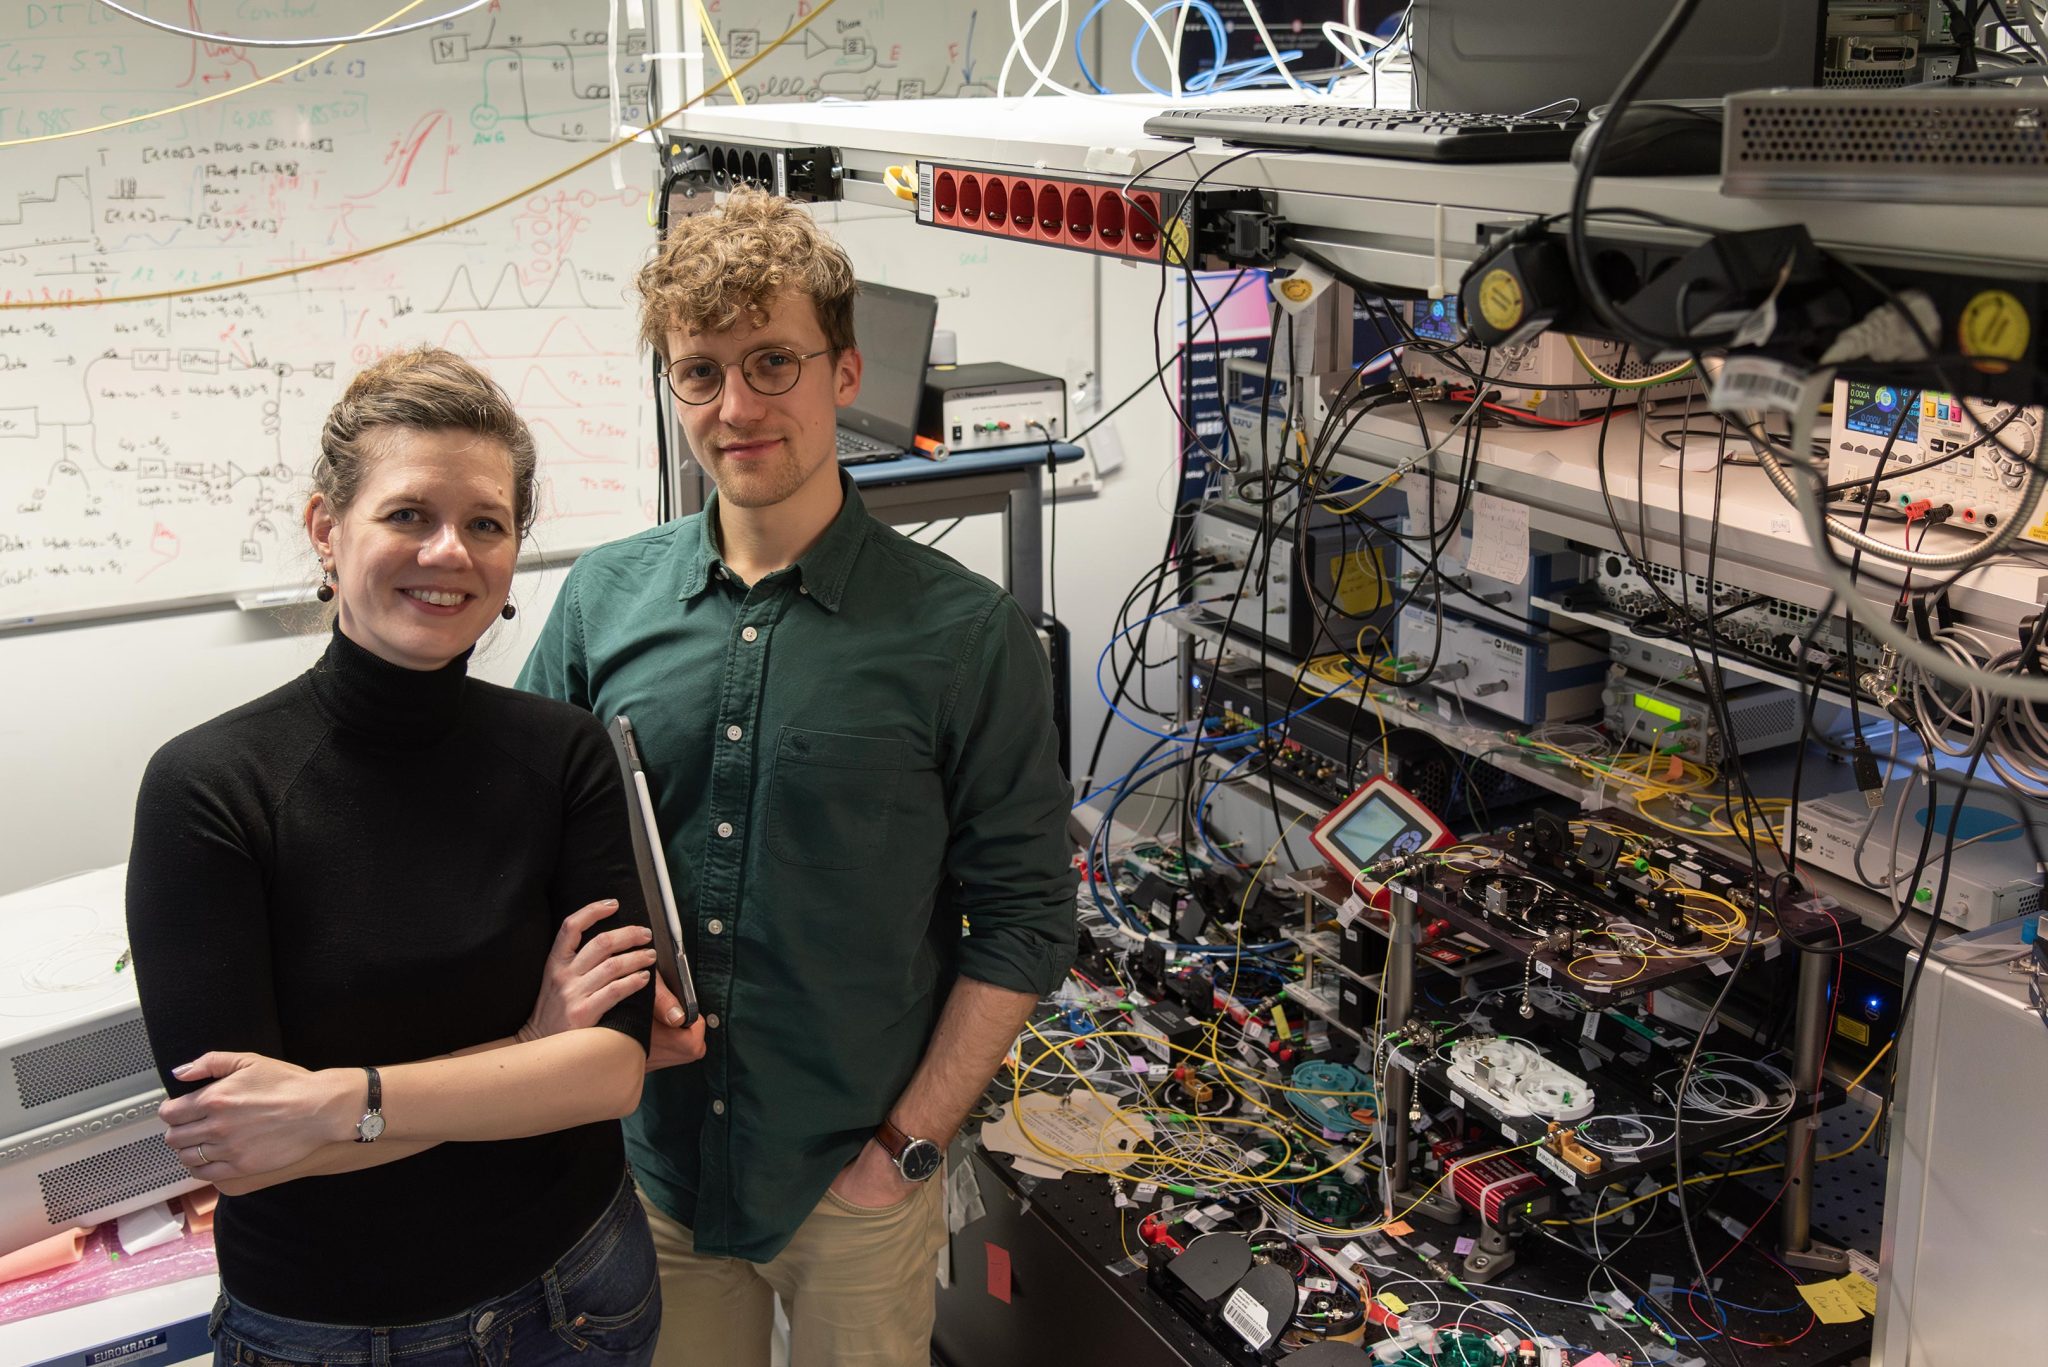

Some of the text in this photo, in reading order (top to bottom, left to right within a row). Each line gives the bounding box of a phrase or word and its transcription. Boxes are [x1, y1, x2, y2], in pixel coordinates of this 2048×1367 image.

[888, 44, 901, 61] E
[1502, 641, 1524, 657] Polytec
[1654, 927, 1676, 942] FPC030
[94, 1335, 158, 1363] EUROKRAFT
